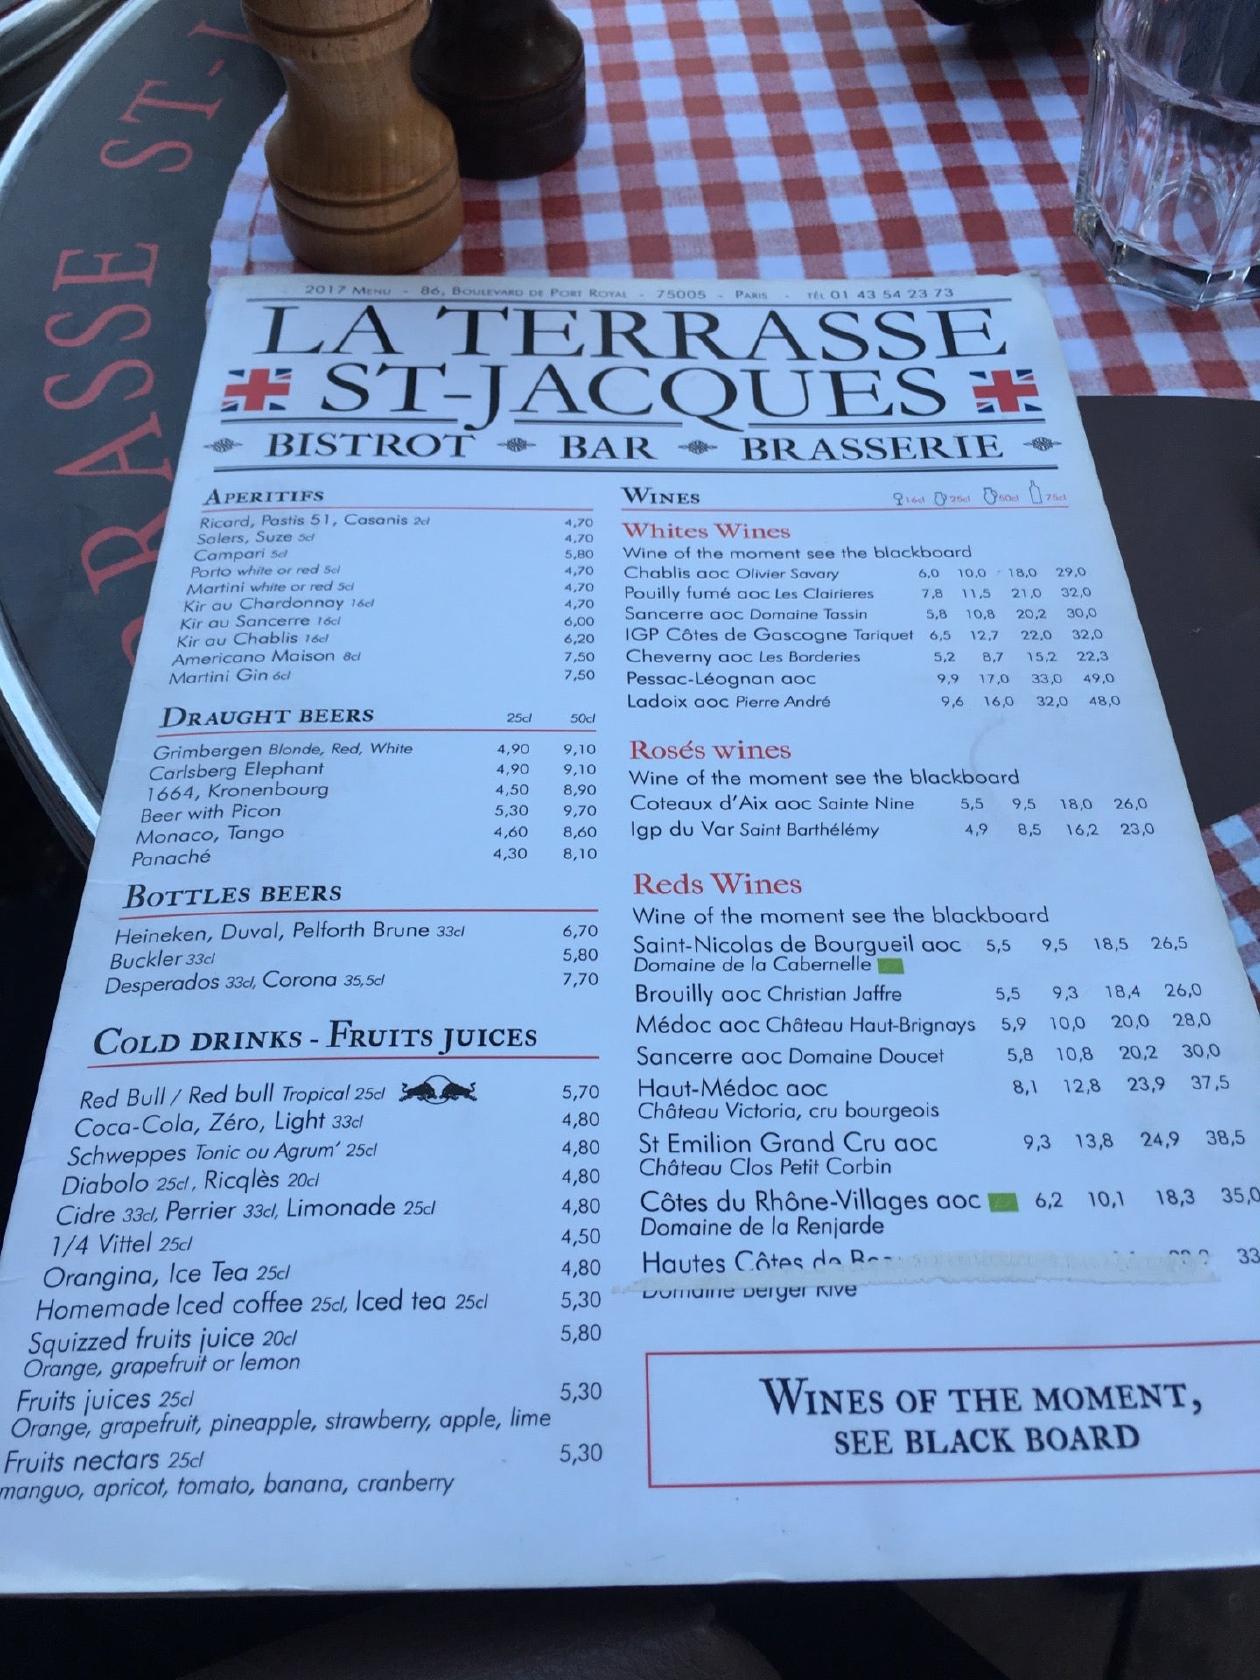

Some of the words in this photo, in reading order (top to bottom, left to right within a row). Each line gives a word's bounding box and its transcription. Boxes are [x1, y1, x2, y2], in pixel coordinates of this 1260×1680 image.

[252, 304, 404, 355] LA
[436, 304, 1008, 361] TERRASSE
[320, 362, 947, 432] ST-JACQUES
[264, 431, 478, 458] BISTROT
[559, 434, 659, 460] BAR
[740, 434, 1004, 462] BRASSERIE
[202, 488, 324, 506] APERITIFS
[620, 486, 700, 505] WINES
[200, 515, 255, 529] Ricard,
[261, 514, 305, 526] Pastis
[310, 514, 337, 527] 51,
[344, 513, 408, 526] Casanis
[414, 516, 430, 525] 2cl
[621, 522, 709, 539] Whites
[713, 523, 791, 539] Wines
[625, 585, 680, 603] Pouilly
[686, 585, 731, 600] fumé
[737, 590, 770, 600] aoc
[775, 588, 798, 599] Les
[803, 587, 874, 599] Clairieres
[922, 588, 943, 599] 7,8
[962, 588, 991, 599] 11,5
[1011, 588, 1042, 599] 21,0
[1061, 587, 1092, 599] 32,0
[171, 652, 266, 667] Americano
[271, 649, 335, 662] Maison
[343, 651, 361, 661] 8cl
[565, 651, 595, 663] 7,50
[168, 670, 230, 685] Martini
[236, 668, 268, 682] Gin
[272, 670, 291, 681] 6cl
[565, 669, 595, 682] 7,50
[627, 671, 775, 689] Pessac-Léognan
[781, 674, 816, 685] aoc
[937, 673, 959, 685] 9,9
[979, 673, 1010, 685] 17,0
[1031, 673, 1063, 685] 33,0
[1083, 673, 1115, 685] 49,0
[158, 706, 292, 729] DRAUGHT
[298, 708, 374, 723] BEERS
[507, 712, 532, 723] 25cl
[570, 713, 596, 724] 50cl
[630, 740, 706, 760] Rosés
[712, 739, 792, 760] wines
[149, 763, 237, 781] Carlsberg
[244, 760, 325, 780] Elephant
[496, 763, 530, 776] 4,90
[563, 763, 597, 777] 9,10
[149, 785, 200, 802] 1664,
[208, 780, 329, 799] Kronenbourg
[495, 783, 529, 797] 4,50
[563, 783, 597, 797] 8,90
[631, 821, 662, 841] Igp
[669, 819, 694, 837] du
[701, 820, 735, 837] Var
[739, 822, 781, 837] Saint
[787, 821, 880, 839] Barthélémy
[131, 848, 211, 867] Panaché
[633, 872, 704, 895] Reds
[709, 872, 802, 895] Wines
[122, 884, 251, 909] BOTTLES
[259, 885, 342, 903] BEERS
[632, 907, 685, 925] Wine
[694, 906, 714, 925] of
[720, 906, 753, 925] the
[760, 908, 845, 924] moment
[852, 912, 886, 924] see
[892, 905, 925, 924] the
[932, 905, 1049, 924] blackboard
[115, 925, 213, 945] Heineken,
[221, 921, 284, 942] Duval,
[293, 920, 365, 938] Pelforth
[373, 920, 430, 938] Brune
[436, 925, 465, 937] 33cl
[562, 924, 598, 940] 6,70
[635, 982, 714, 1007] Brouilly
[721, 989, 762, 1003] aoc
[767, 984, 846, 1002] Christian
[853, 984, 902, 1002] Jaffre
[995, 986, 1021, 1002] 5,5
[1052, 985, 1079, 1001] 9,3
[1105, 984, 1140, 1000] 18,4
[1164, 983, 1202, 999] 26,0
[93, 1027, 181, 1056] COLD
[189, 1030, 302, 1052] DRINKS
[325, 1020, 433, 1048] FRUITS
[437, 1027, 538, 1055] JUICES
[74, 1112, 200, 1138] Coca-Cola,
[208, 1112, 265, 1134] Zéro,
[275, 1109, 326, 1135] Light
[332, 1114, 364, 1129] 33cl
[562, 1111, 600, 1129] 4,80
[639, 1132, 660, 1154] St
[668, 1131, 752, 1154] Emilion
[760, 1130, 835, 1153] Grand
[843, 1130, 885, 1153] Cru
[894, 1137, 938, 1152] aoc
[1023, 1134, 1051, 1152] 9,3
[1075, 1132, 1114, 1151] 13,8
[1140, 1131, 1180, 1149] 24,9
[1206, 1129, 1246, 1147] 38,5
[640, 1190, 708, 1213] Côtes
[716, 1188, 746, 1213] du
[755, 1187, 929, 1216] Rhône-Villages
[936, 1194, 982, 1210] aoc
[642, 1251, 727, 1274] Hautes
[43, 1265, 159, 1292] Orangina,
[169, 1262, 201, 1284] Ice
[212, 1260, 248, 1282] Tea
[256, 1264, 291, 1281] 25cl
[561, 1258, 601, 1279] 4,80
[28, 1326, 129, 1357] Squizzed
[136, 1326, 192, 1350] fruits
[199, 1326, 255, 1355] juice
[262, 1329, 298, 1347] 20cl
[560, 1323, 602, 1345] 5,80
[758, 1378, 884, 1416] WINES
[895, 1388, 937, 1414] OF
[948, 1387, 1023, 1414] THE
[1031, 1382, 1202, 1416] MOMENT,
[11, 1417, 91, 1441] Orange,
[99, 1411, 201, 1440] grapefruit,
[209, 1409, 317, 1438] pineapple,
[325, 1408, 431, 1434] strawberry,
[439, 1406, 501, 1433] apple,
[510, 1406, 551, 1427] lime
[834, 1429, 893, 1456] SEE
[904, 1427, 1016, 1455] BLACK
[1024, 1424, 1141, 1453] BOARD
[3, 1449, 65, 1474] Fruits
[73, 1449, 160, 1472] nectars
[167, 1450, 205, 1469] 25cl
[559, 1443, 603, 1466] 5,30
